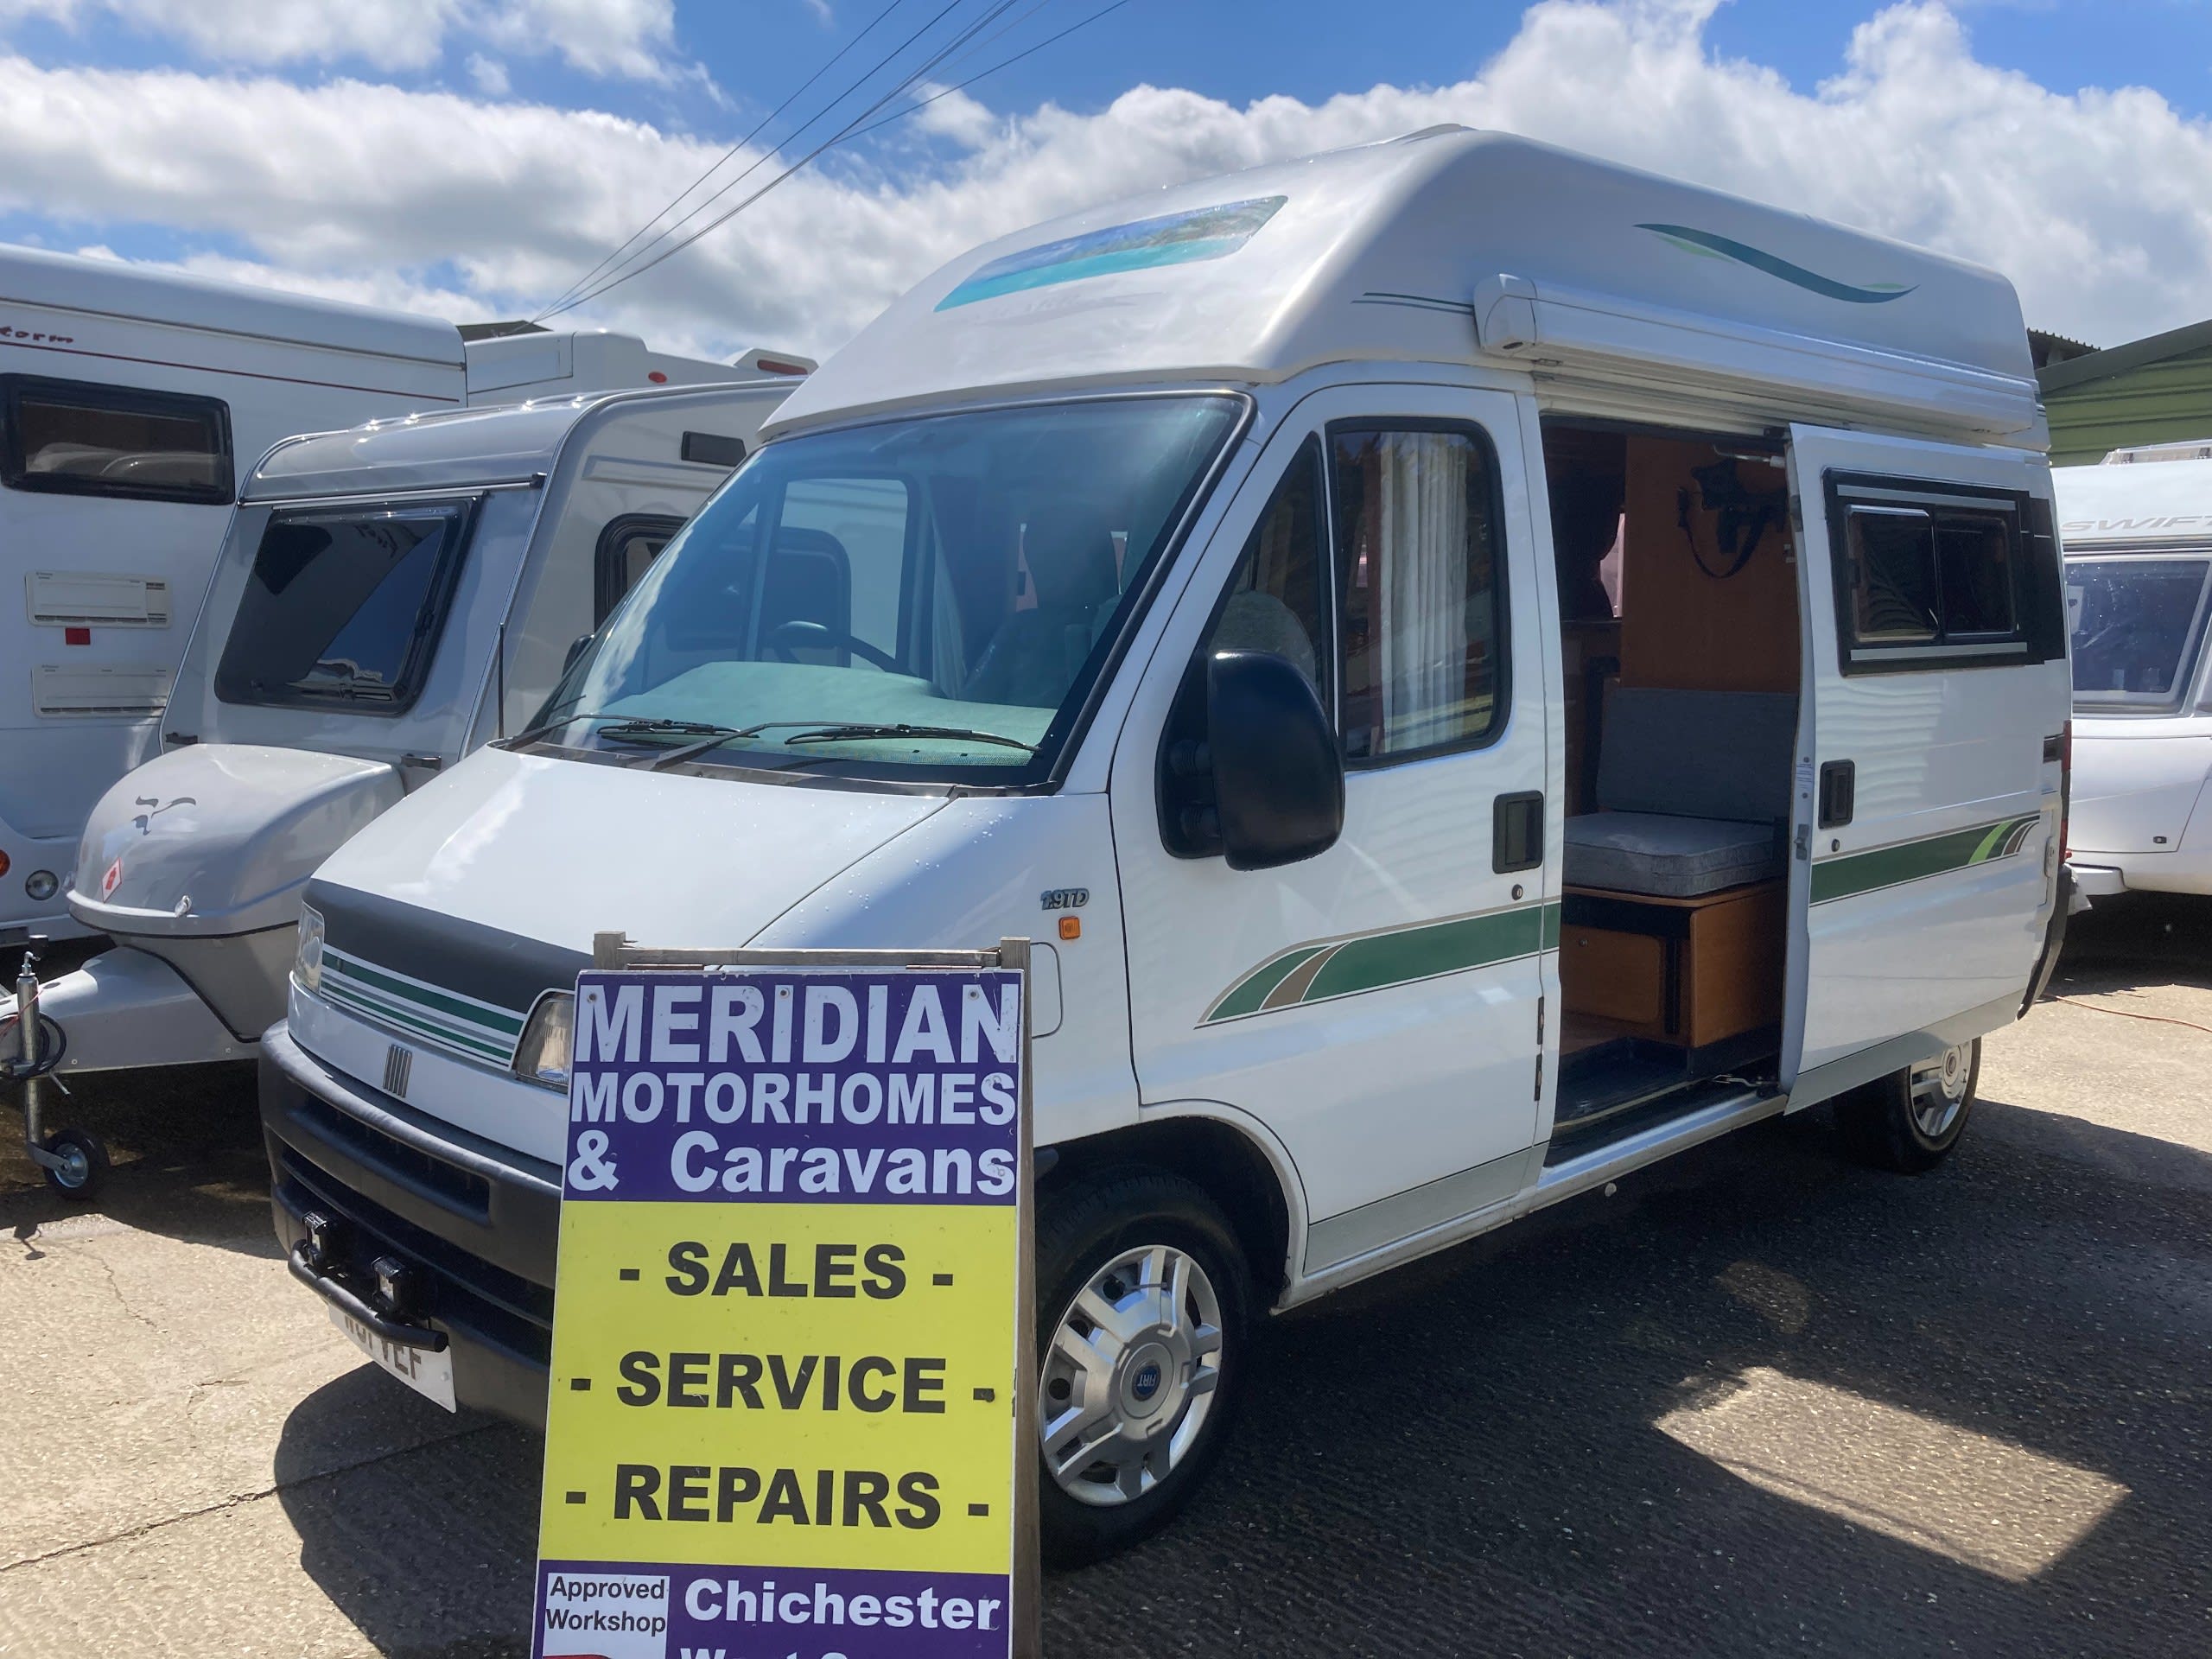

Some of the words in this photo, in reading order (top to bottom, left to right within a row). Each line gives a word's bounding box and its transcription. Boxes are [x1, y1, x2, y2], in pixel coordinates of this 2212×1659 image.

[574, 984, 1019, 1063] MERIDIAN
[569, 1071, 1016, 1125] MOTORHOMES
[567, 1129, 620, 1192] &
[671, 1130, 1015, 1195] Caravans
[664, 1241, 906, 1299] SALES
[616, 1351, 946, 1414] SERVICE
[613, 1464, 941, 1529] REPAIRS
[550, 1576, 665, 1600] Approved
[684, 1579, 1001, 1630] Chichester
[545, 1608, 666, 1637] Workshop
